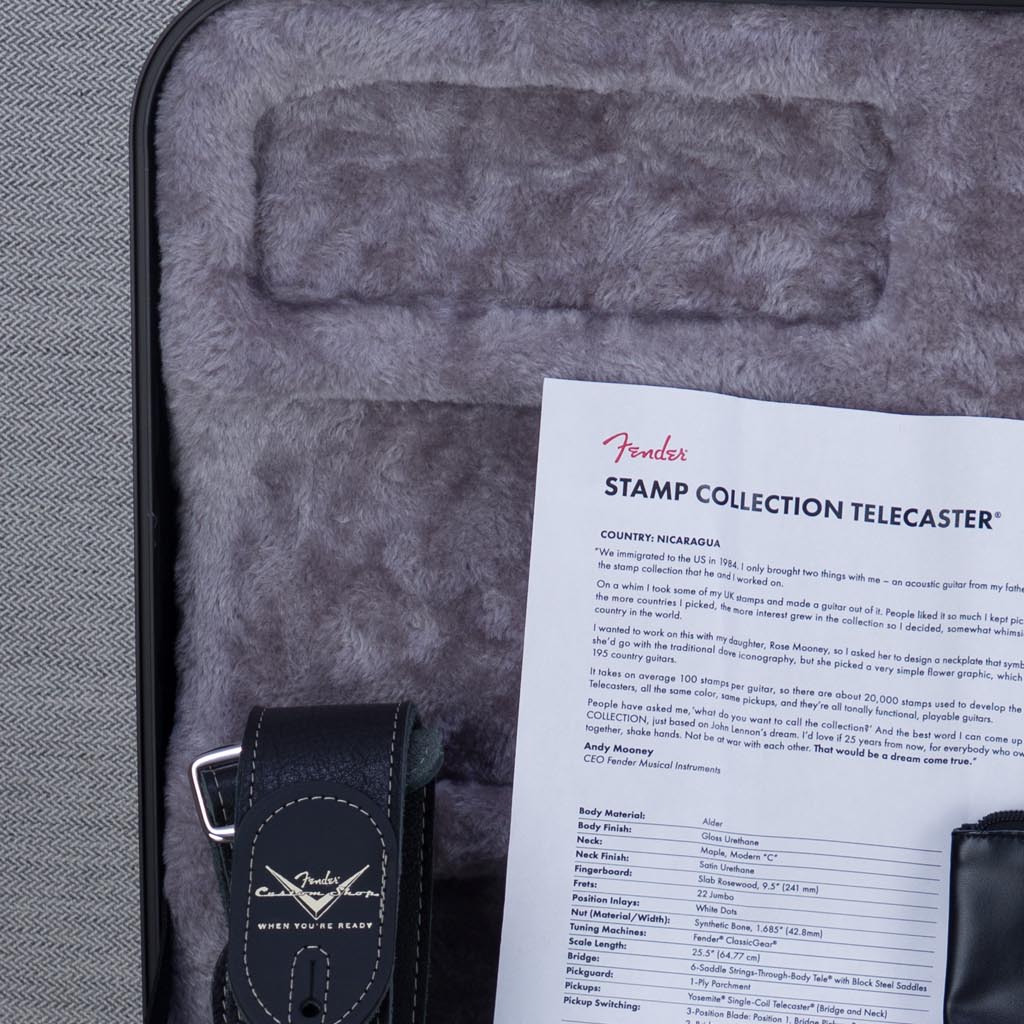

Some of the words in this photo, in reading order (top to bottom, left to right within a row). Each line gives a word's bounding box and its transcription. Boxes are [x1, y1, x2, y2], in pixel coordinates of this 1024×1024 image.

[603, 432, 687, 463] Fender
[604, 477, 688, 500] STAMP
[696, 484, 843, 519] COLLECTION
[600, 530, 654, 542] COUNTRY:
[657, 535, 720, 547] NICARAGUA
[598, 560, 611, 569] the
[614, 563, 639, 573] stamp
[642, 564, 682, 574] collection
[685, 567, 701, 576] that
[704, 568, 714, 577] he
[717, 572, 731, 580] and
[737, 576, 768, 585] worked
[584, 742, 610, 753] Andy
[613, 744, 653, 757] Mooney
[583, 754, 604, 764] CEO
[607, 756, 636, 766] Fender
[638, 759, 673, 769] Musical
[675, 761, 720, 774] Instruments
[579, 807, 602, 817] Body
[604, 809, 645, 819] Material:
[578, 822, 601, 832] Body
[603, 824, 631, 832] Finish:
[702, 818, 723, 827] Alder
[577, 836, 602, 845] Neck:
[701, 832, 722, 843] Gloss
[724, 835, 759, 846] Urethane
[576, 850, 598, 859] Neck
[601, 852, 629, 861] Finish:
[574, 864, 632, 876] Fingerboard:
[699, 861, 718, 869] Satin
[720, 863, 754, 874] Urethane
[294, 870, 340, 888] Fender
[573, 879, 597, 888] Frets:
[254, 886, 324, 896] Custom
[329, 886, 380, 898] Shop
[697, 889, 707, 897] 22
[709, 891, 734, 900] Jumbo
[572, 894, 607, 903] Position
[610, 897, 639, 907] Inlays:
[696, 904, 718, 913] White
[720, 906, 737, 915] Dots
[571, 908, 587, 917] Nut
[590, 909, 670, 925] (Material/Width):
[258, 922, 290, 930] WHEN
[294, 922, 334, 930] YOU'RE
[570, 922, 600, 934] Tuning
[602, 925, 646, 936] Machines:
[569, 937, 592, 946] Scale
[594, 939, 626, 950] Length:
[567, 952, 599, 963] Bridge:
[566, 967, 613, 978] Pickguard:
[565, 981, 600, 992] Pickups:
[563, 996, 592, 1007] Pickup
[595, 999, 640, 1012] Switching:
